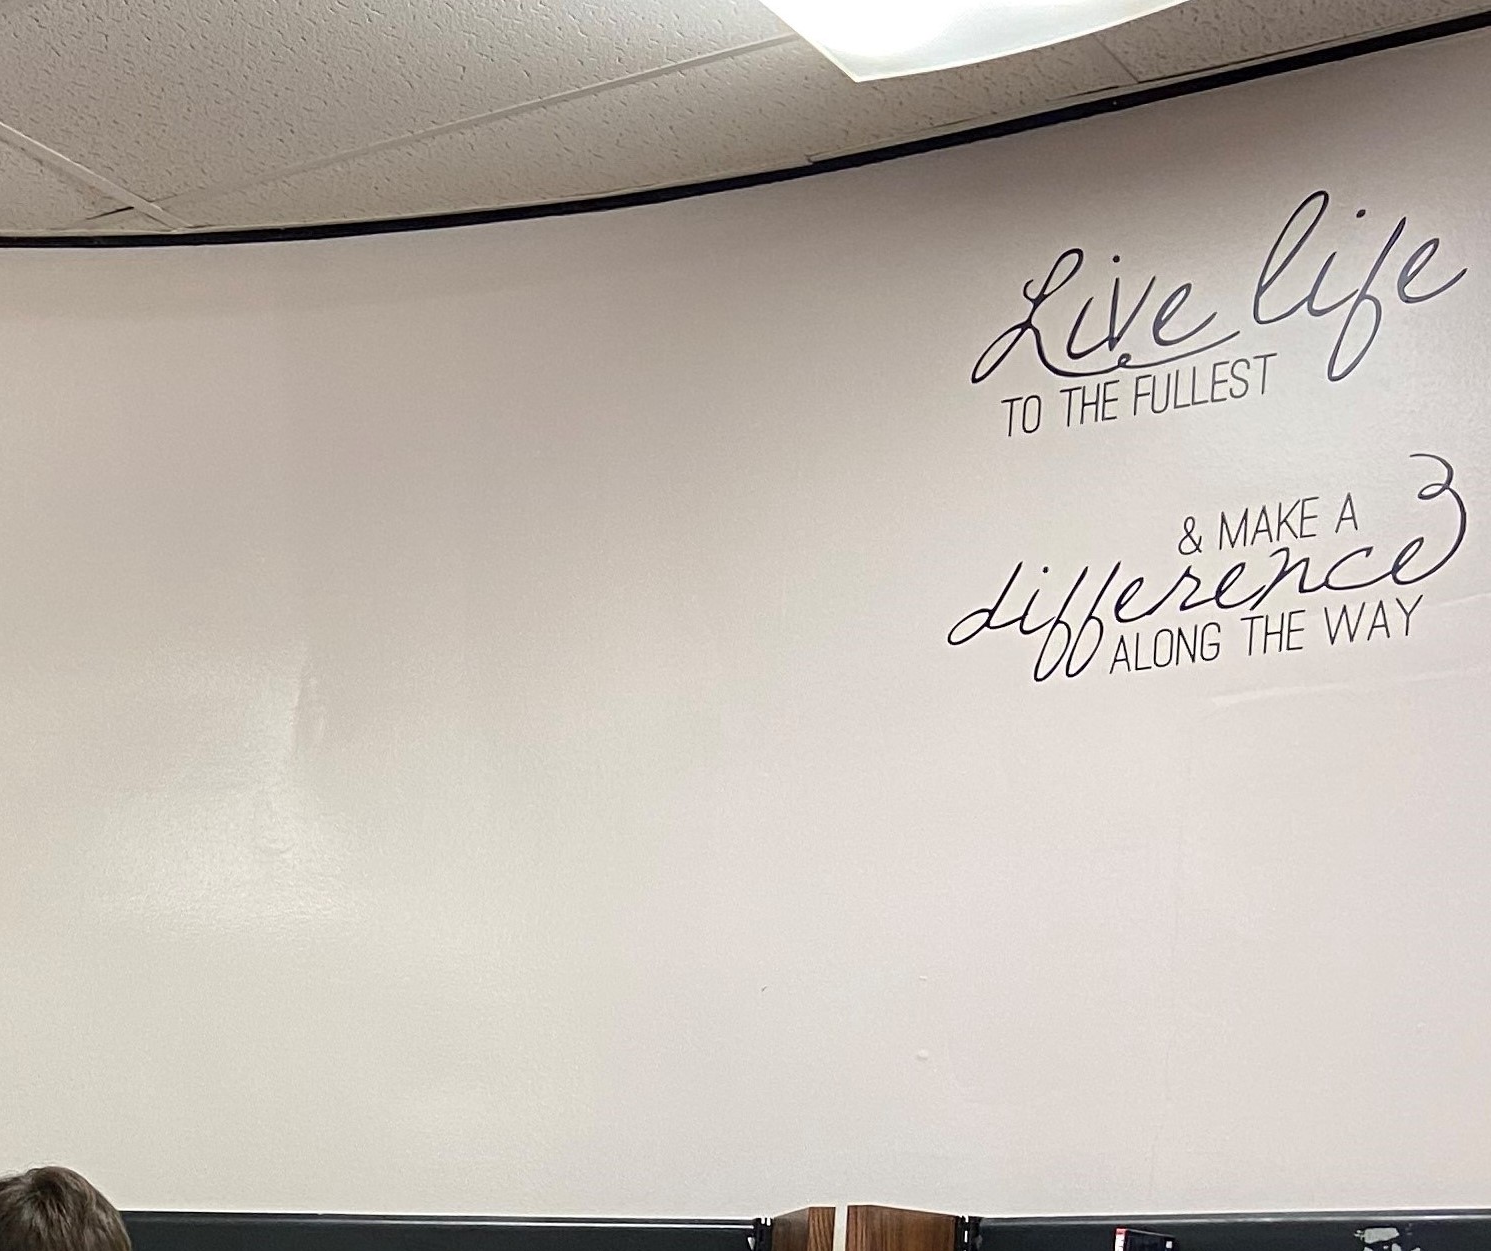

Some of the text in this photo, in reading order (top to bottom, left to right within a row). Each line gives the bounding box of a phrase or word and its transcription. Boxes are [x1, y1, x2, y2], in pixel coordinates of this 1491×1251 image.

[971, 190, 1468, 383] Live life
[1002, 353, 1277, 437] TO THE FULLEST
[1178, 493, 1359, 555] & MAKE A
[947, 454, 1467, 682] difference
[1110, 595, 1423, 674] ALONG THE WAY
